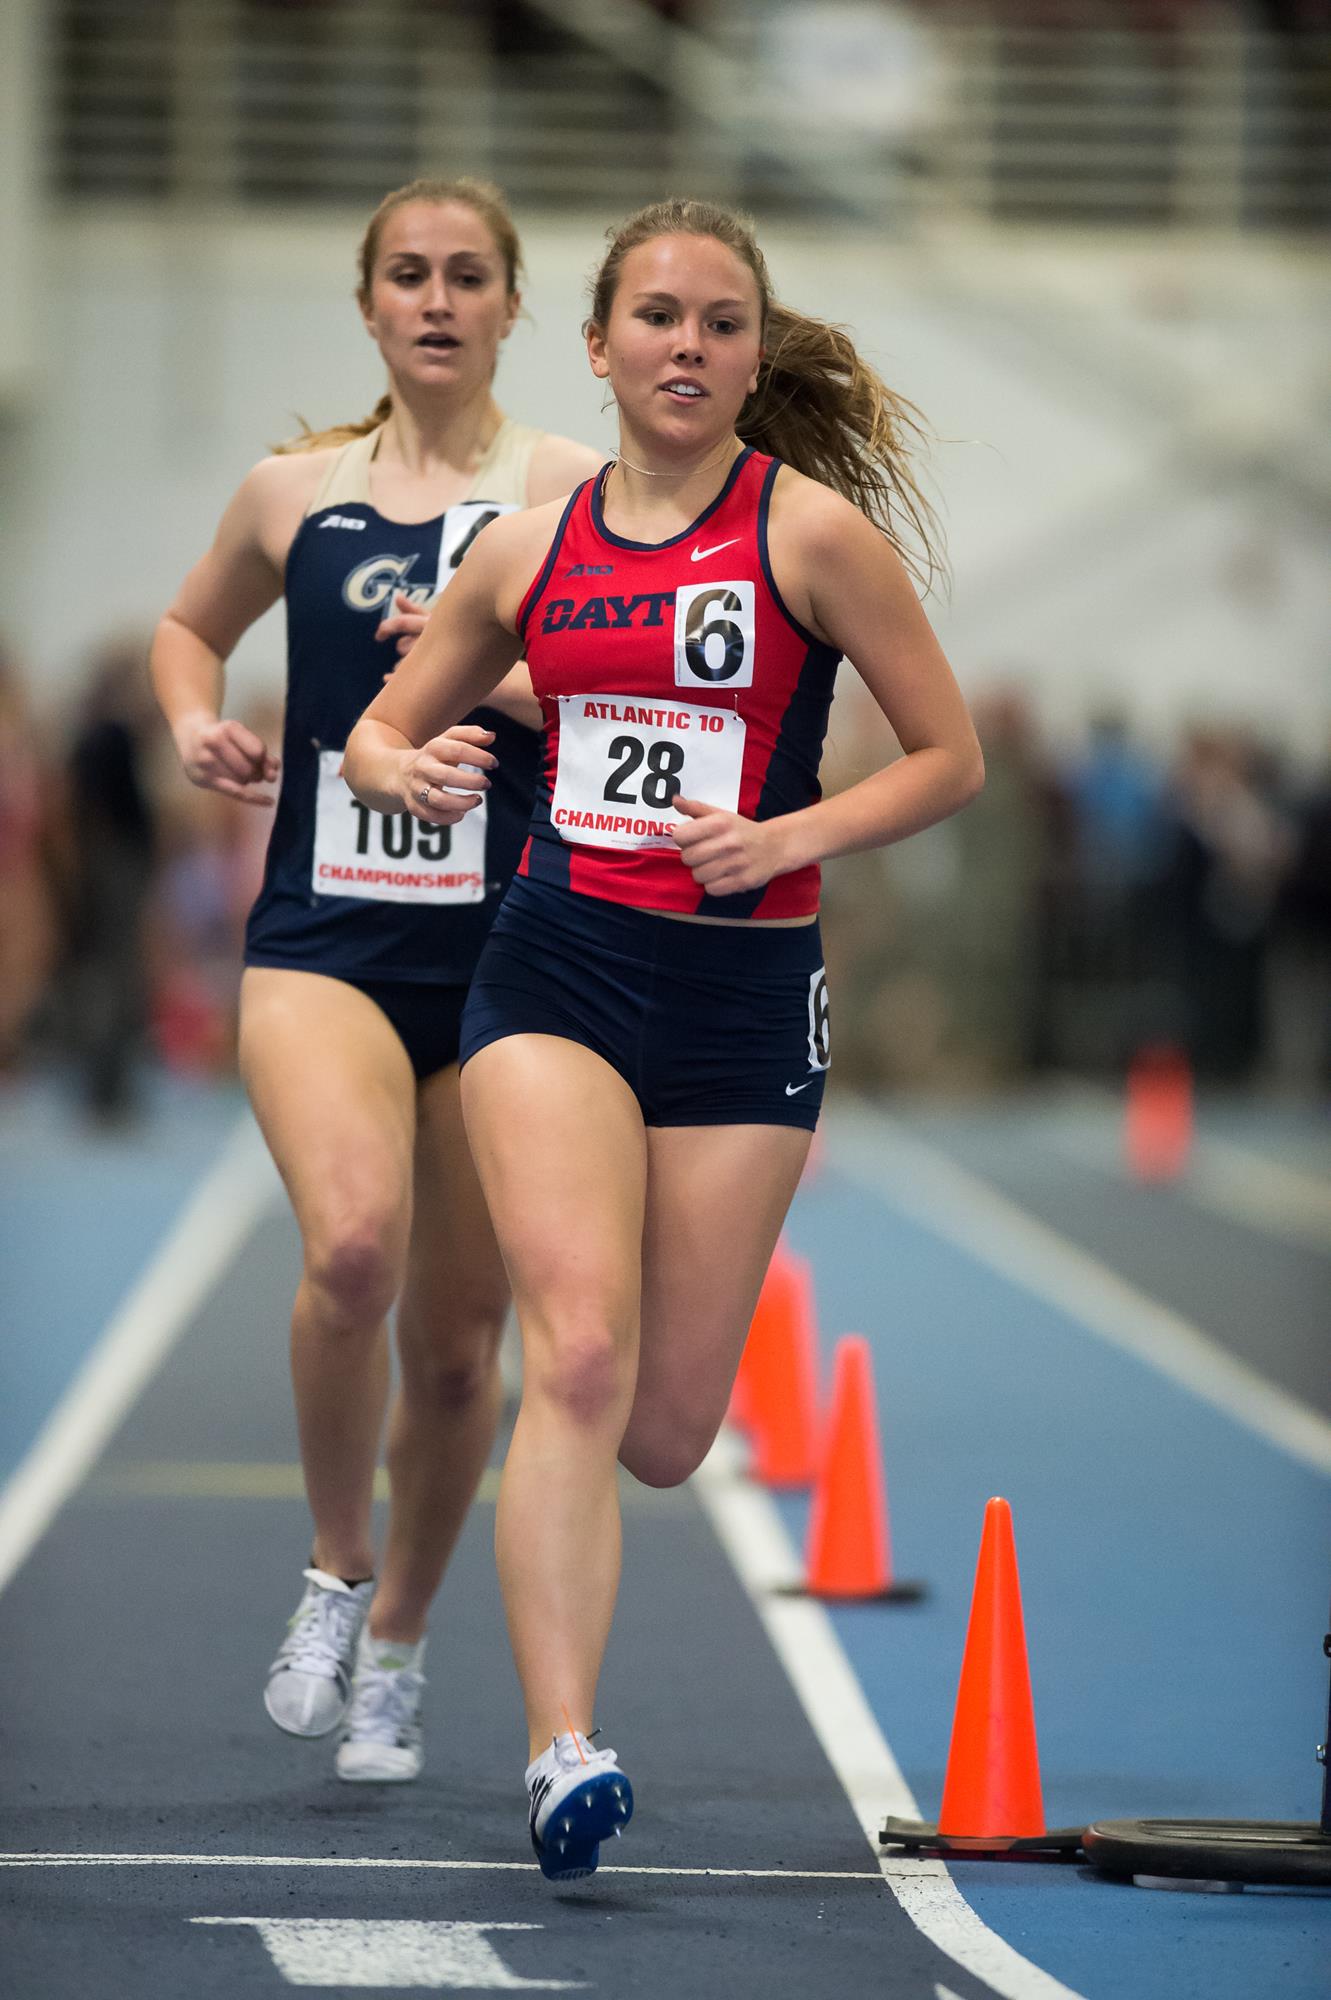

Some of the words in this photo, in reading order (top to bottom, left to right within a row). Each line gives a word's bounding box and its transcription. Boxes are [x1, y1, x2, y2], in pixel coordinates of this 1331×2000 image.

[563, 563, 614, 578] A10
[541, 591, 676, 635] DAYT
[685, 588, 745, 682] 6
[583, 701, 691, 730] ATLANTIC
[699, 714, 724, 733] 10
[602, 734, 685, 809] 28
[350, 799, 452, 862] 109
[554, 808, 677, 837] CHAMPIONS
[318, 863, 483, 889] CHAMPIONSHIPS
